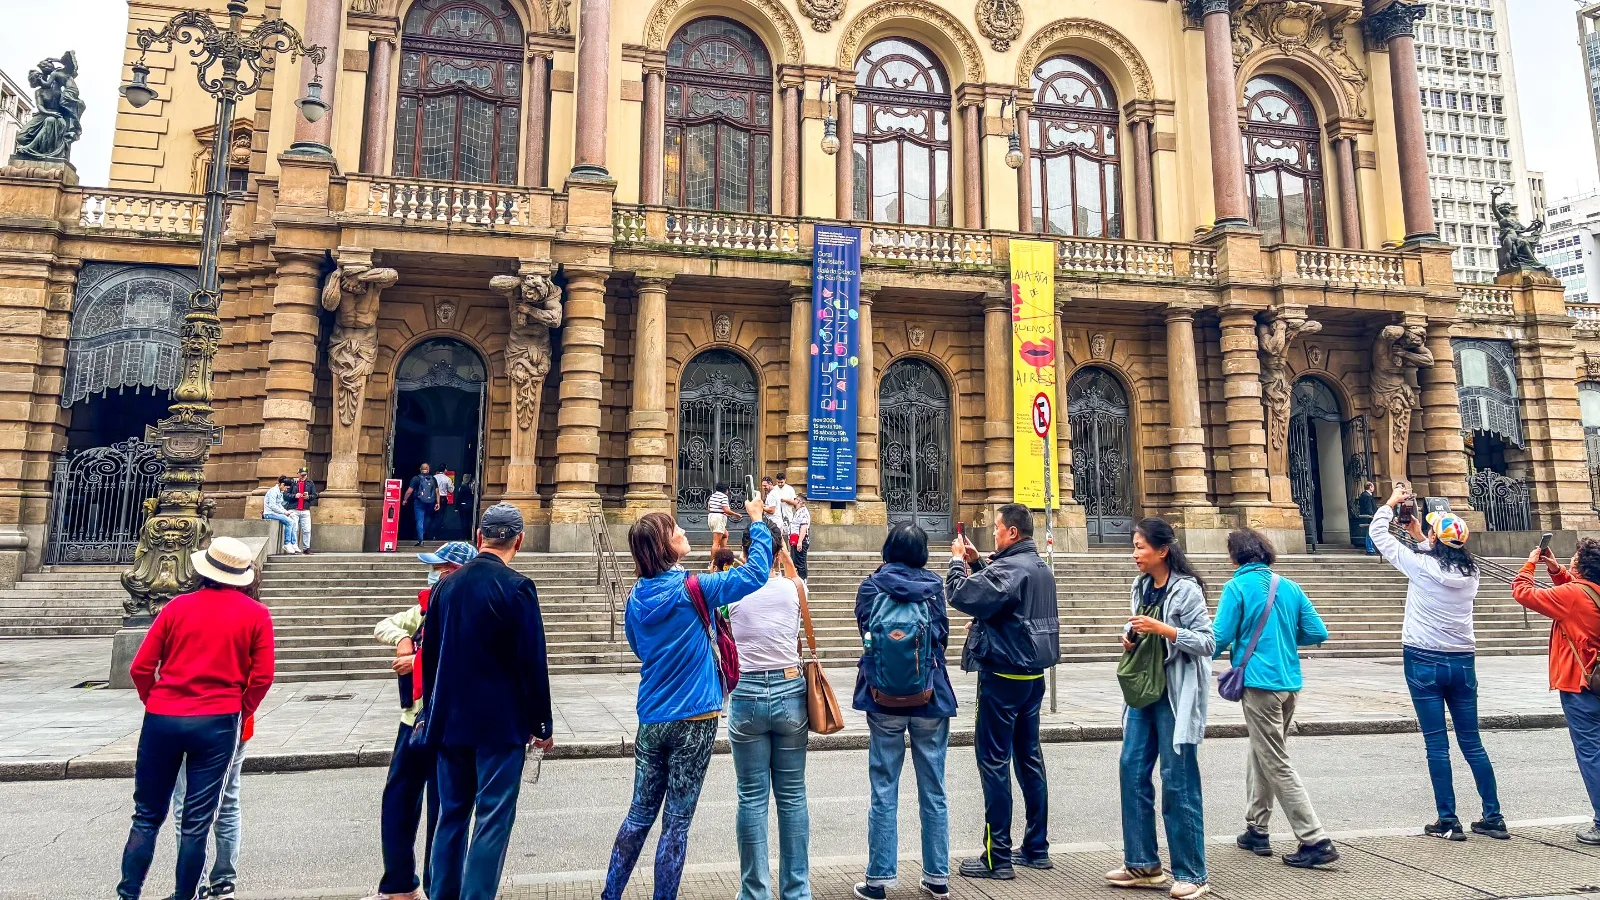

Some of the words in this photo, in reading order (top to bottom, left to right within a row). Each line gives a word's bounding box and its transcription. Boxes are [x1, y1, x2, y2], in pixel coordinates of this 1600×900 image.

[822, 287, 834, 355] MONDAY
[1013, 323, 1052, 333] BUENOS
[821, 362, 833, 409] BLUE
[1016, 370, 1053, 387] AIRES
